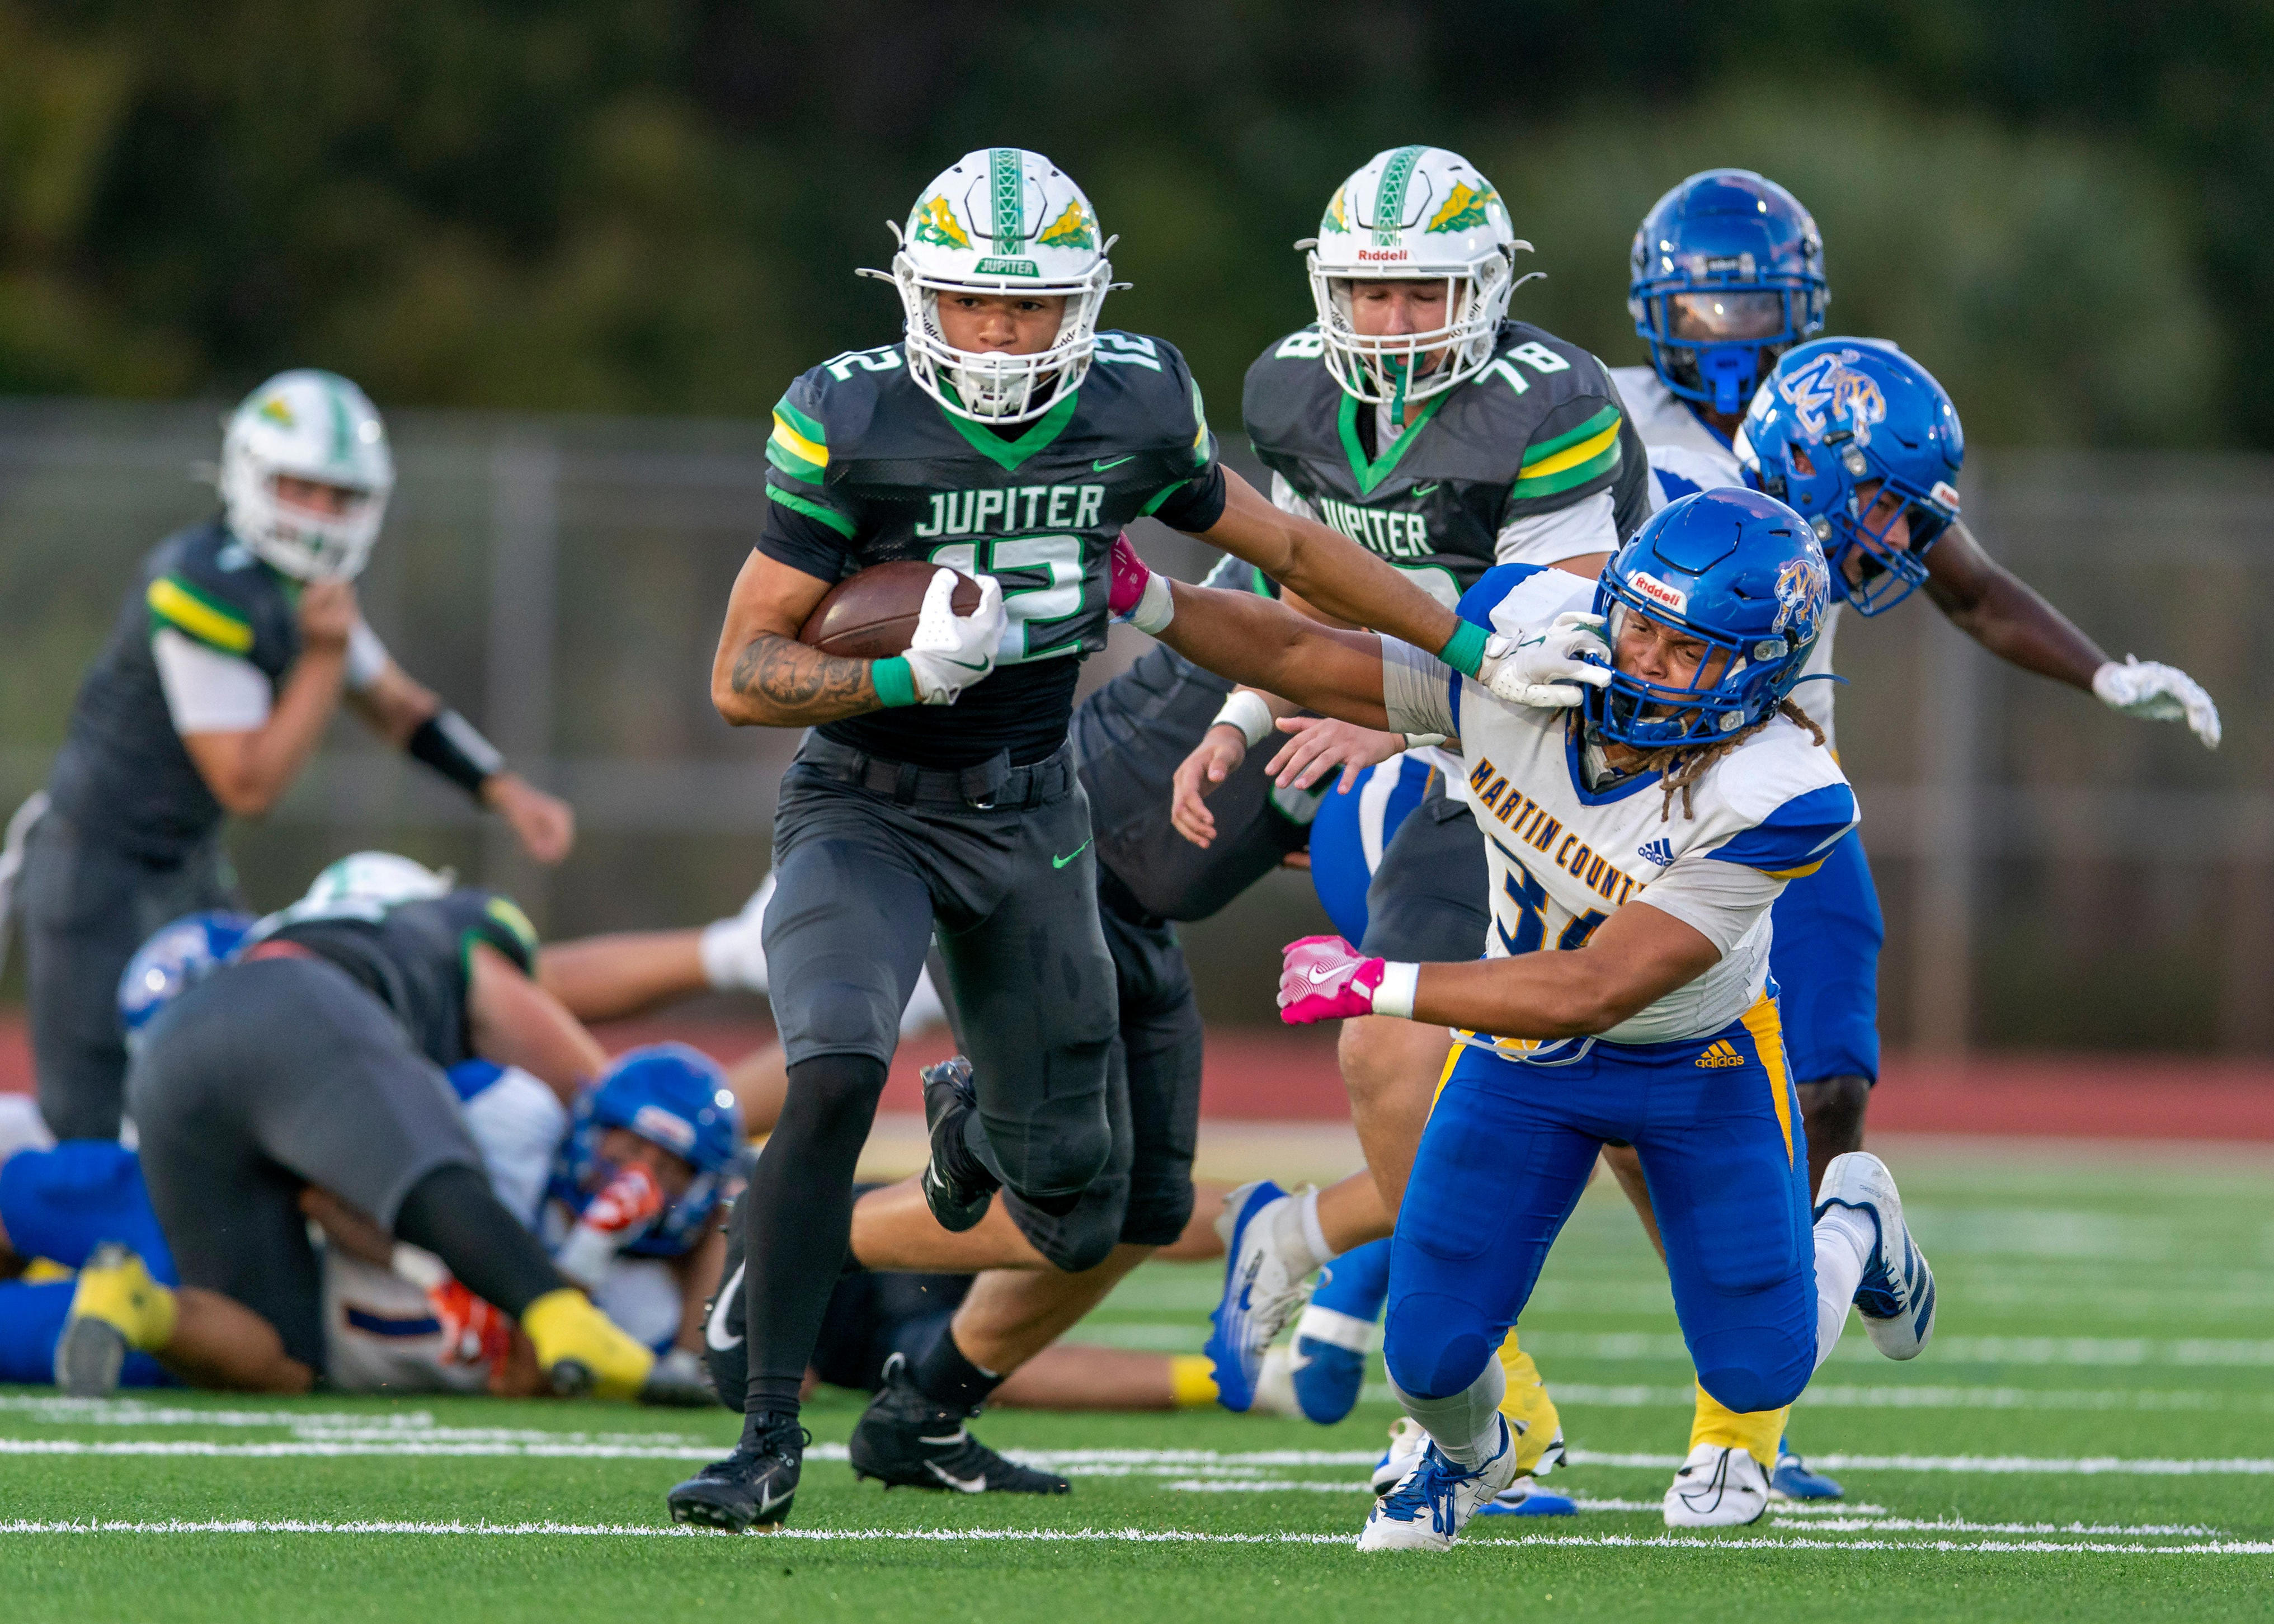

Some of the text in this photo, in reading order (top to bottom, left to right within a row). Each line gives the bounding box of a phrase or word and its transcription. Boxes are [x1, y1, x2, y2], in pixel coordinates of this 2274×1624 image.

[980, 260, 1033, 275] JUPITER
[1358, 250, 1408, 261] Riddell
[1091, 333, 1164, 373] 12
[1472, 341, 1571, 397] 78
[915, 484, 1105, 538] JUPITER
[1635, 577, 1681, 606] Riddell
[1470, 756, 1648, 907] MARTIN COUNT
[1638, 847, 1674, 867] adida
[1695, 1055, 1745, 1068] adidas
